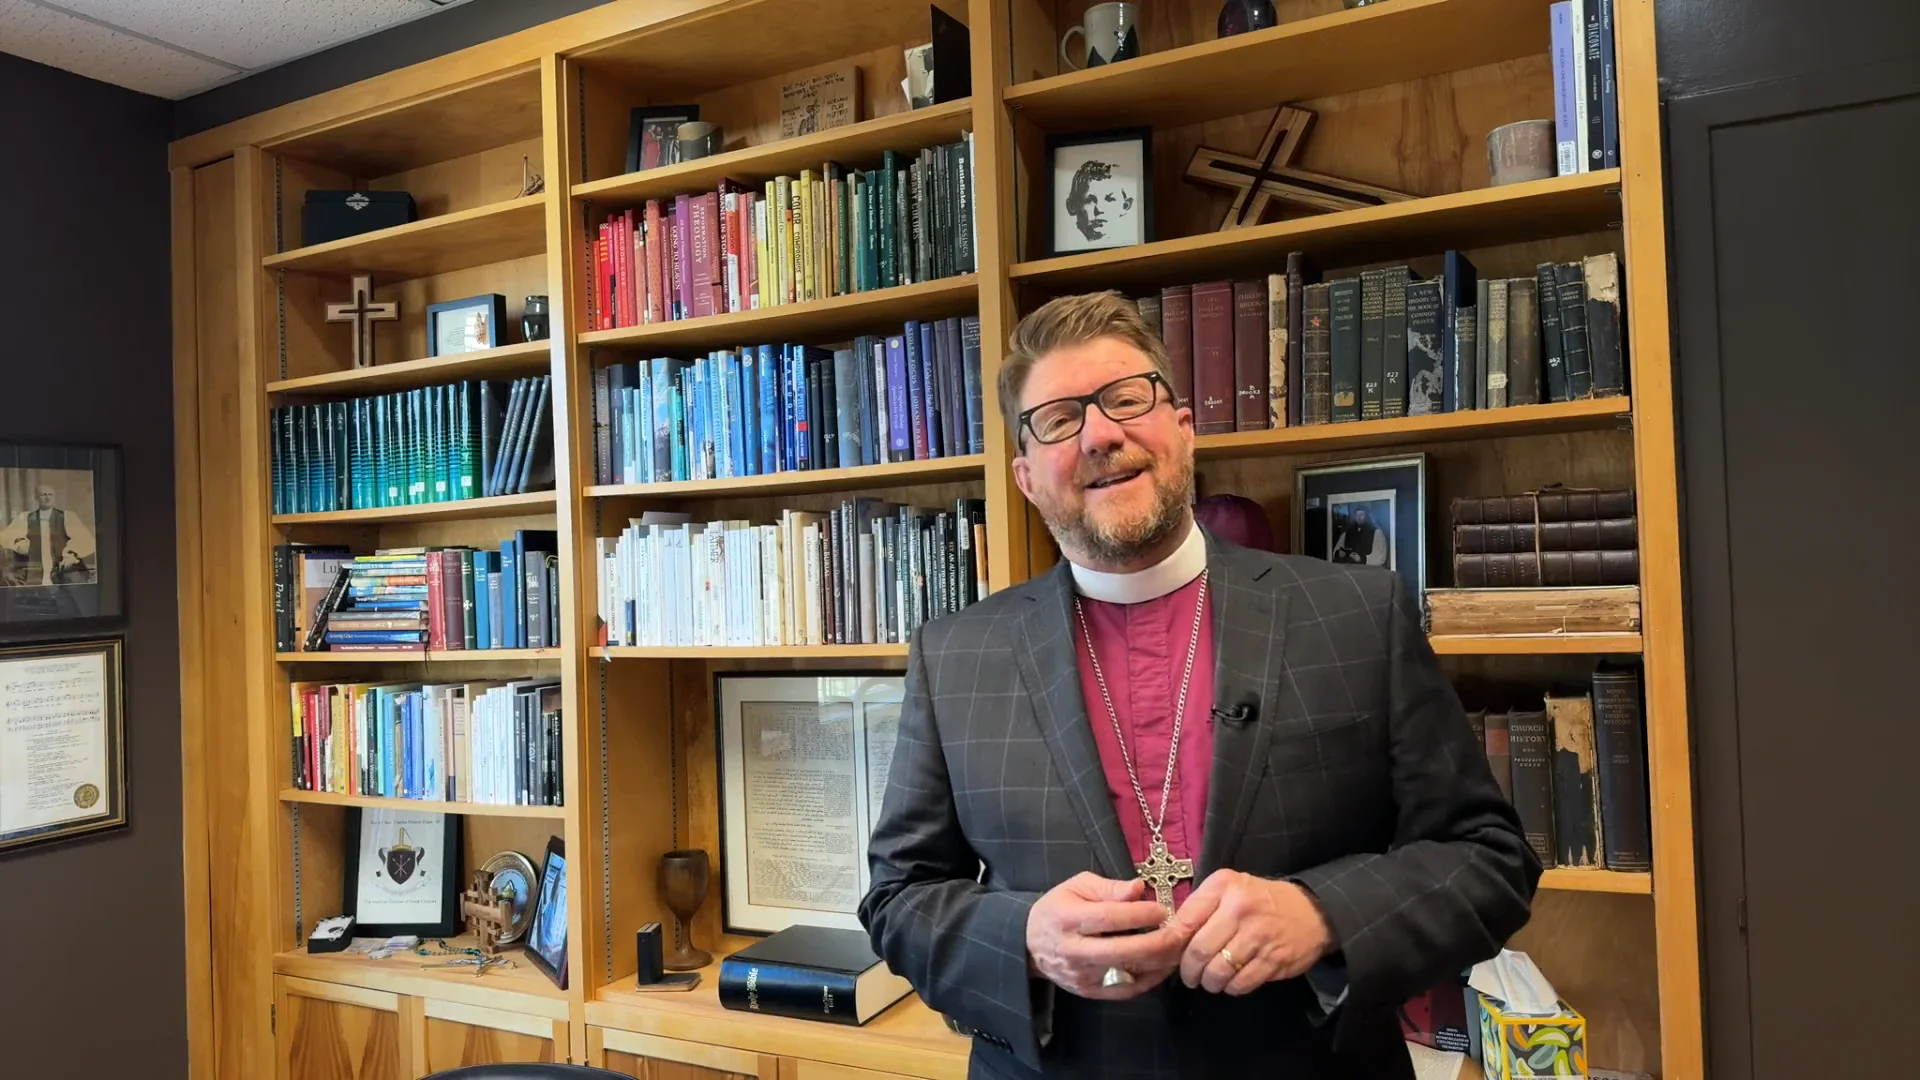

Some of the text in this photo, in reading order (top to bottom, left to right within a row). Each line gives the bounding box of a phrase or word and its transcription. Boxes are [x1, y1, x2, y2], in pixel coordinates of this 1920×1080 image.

[1587, 23, 1600, 60] DIACONATE
[958, 157, 966, 208] Battlefields
[792, 196, 801, 224] COLOR
[693, 204, 702, 264] THEOLOGY
[720, 223, 726, 233] IN
[673, 251, 679, 260] TO
[709, 531, 719, 563] LATIMER
[275, 583, 284, 613] Paul
